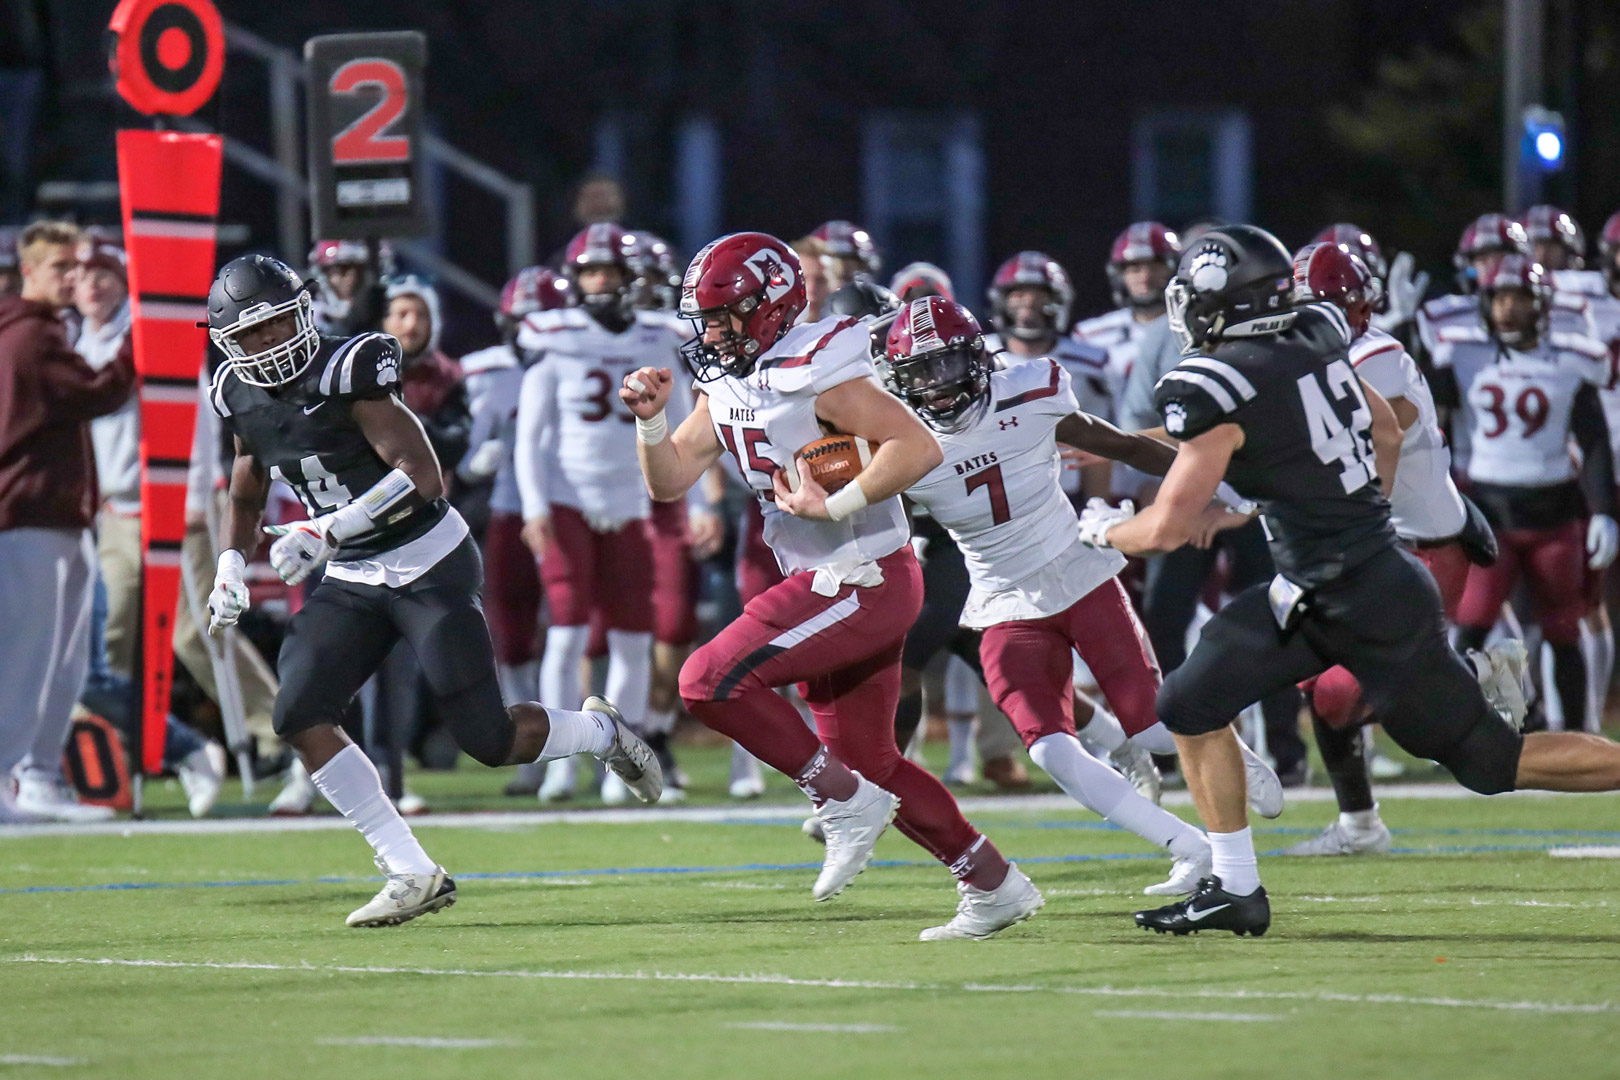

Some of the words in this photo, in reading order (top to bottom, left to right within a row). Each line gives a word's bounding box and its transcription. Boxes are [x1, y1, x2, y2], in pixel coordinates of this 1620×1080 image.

[329, 57, 410, 165] 2
[729, 407, 756, 422] BATES
[1297, 359, 1378, 495] 42
[1480, 384, 1550, 439] 39
[270, 454, 353, 517] 14
[718, 422, 784, 502] 15
[953, 451, 998, 476] BATES
[964, 463, 1011, 526] 7
